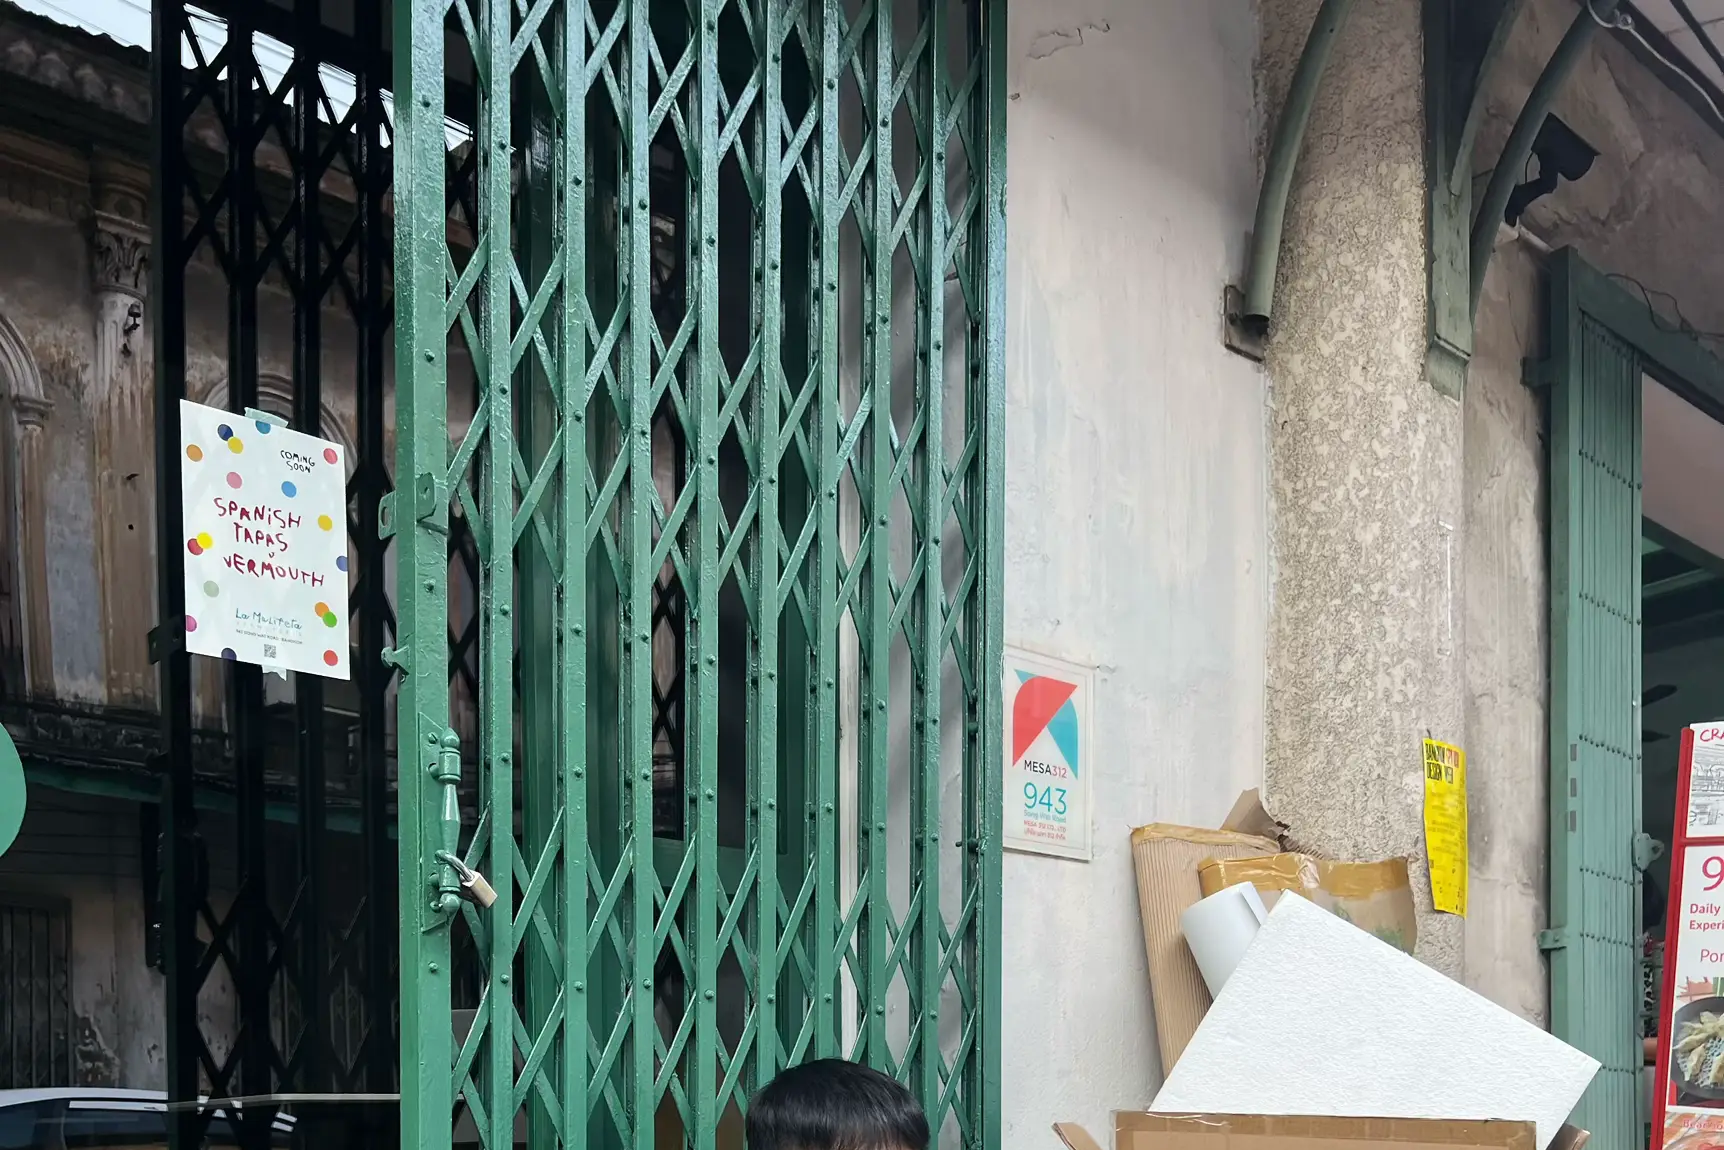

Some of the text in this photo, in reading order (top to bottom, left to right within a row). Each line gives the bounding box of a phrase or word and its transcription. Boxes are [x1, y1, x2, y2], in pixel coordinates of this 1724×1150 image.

[280, 450, 315, 467] COMING
[286, 461, 311, 473] SOON
[233, 522, 288, 552] TAPAS
[223, 553, 324, 587] VERMOUTH
[1024, 781, 1067, 815] 943
[1689, 903, 1721, 916] Daily
